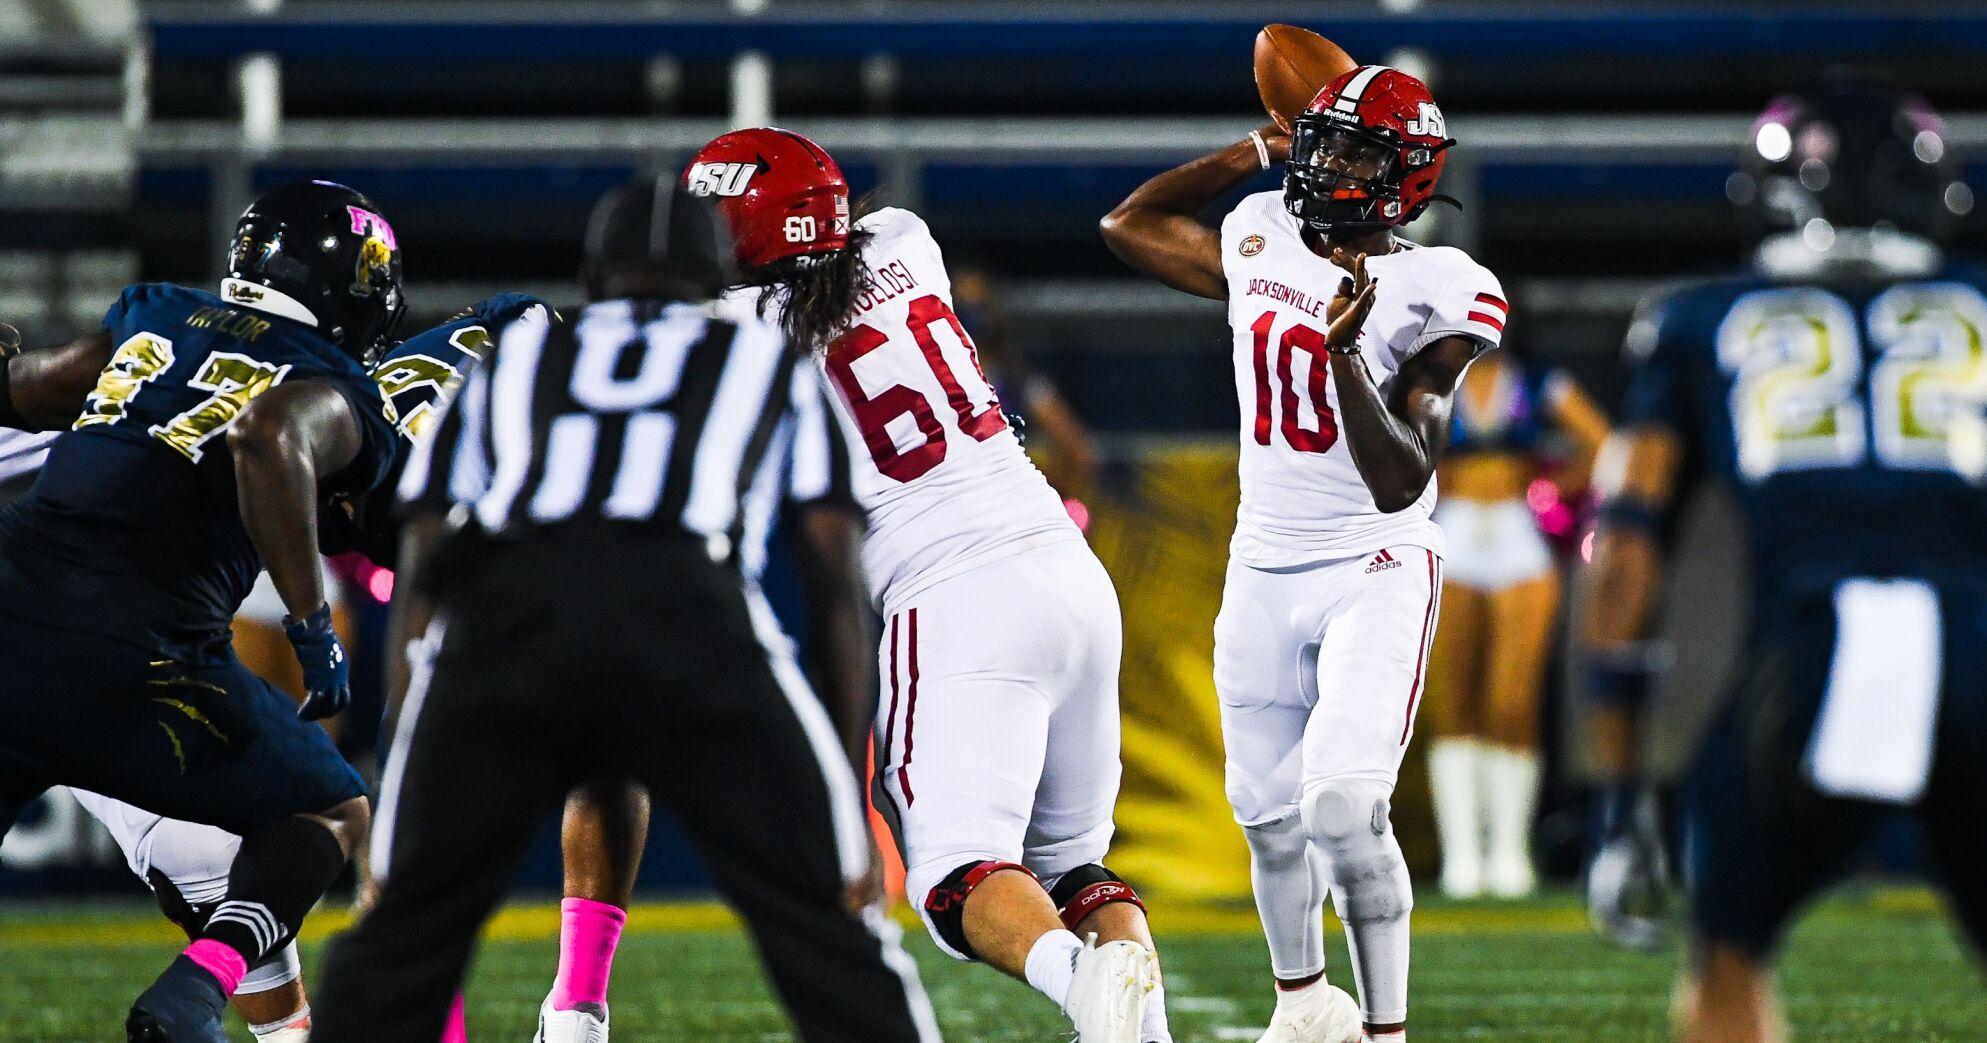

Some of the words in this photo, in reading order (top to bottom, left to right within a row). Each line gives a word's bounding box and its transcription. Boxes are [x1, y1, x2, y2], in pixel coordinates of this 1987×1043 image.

[782, 215, 816, 243] 60
[1246, 278, 1325, 318] JACKSONVILLE
[824, 293, 1007, 483] 60
[1250, 310, 1339, 453] 10
[1716, 280, 1987, 484] 22
[1364, 560, 1402, 574] adidas
